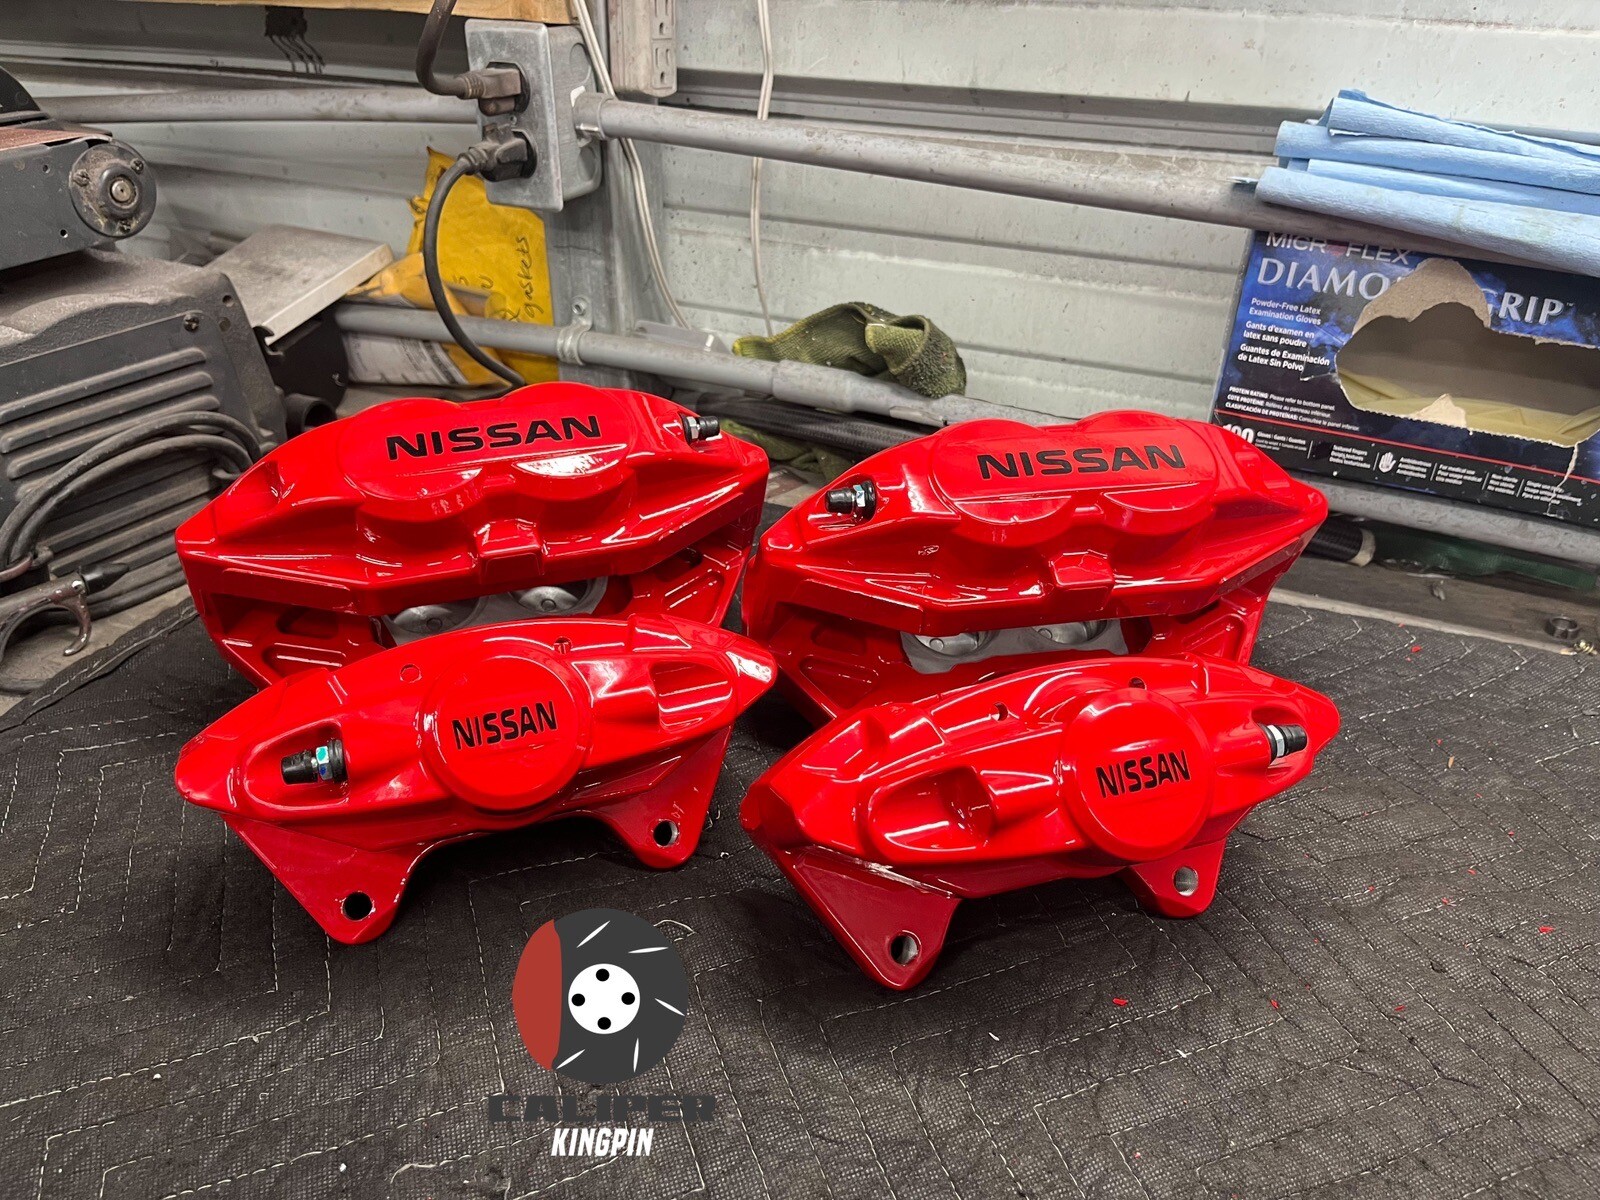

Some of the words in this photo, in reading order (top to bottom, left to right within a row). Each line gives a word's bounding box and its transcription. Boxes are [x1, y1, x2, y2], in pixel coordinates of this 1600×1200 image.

[516, 236, 545, 318] gaskets
[1257, 257, 1401, 300] DIAMO
[1249, 307, 1294, 321] Examination
[1295, 314, 1321, 326] Gloves
[1251, 297, 1299, 312] Powder-Free
[1299, 304, 1321, 315] Latex
[1243, 329, 1261, 340] latex
[1261, 334, 1279, 343] sans
[1279, 337, 1307, 348] poudre
[1245, 320, 1267, 331] Gants
[1267, 324, 1304, 337] d'examen
[1304, 331, 1315, 339] en
[1237, 353, 1247, 362] de
[1248, 354, 1268, 365] Latex
[1269, 358, 1281, 367] Sin
[1282, 361, 1304, 372] Polvo
[1240, 343, 1270, 356] Guantes
[1270, 348, 1280, 358] de
[387, 415, 600, 460] NISSAN
[978, 443, 1185, 479] NISSAN
[453, 702, 557, 750] NISSAN
[1097, 750, 1191, 797] NISSAN
